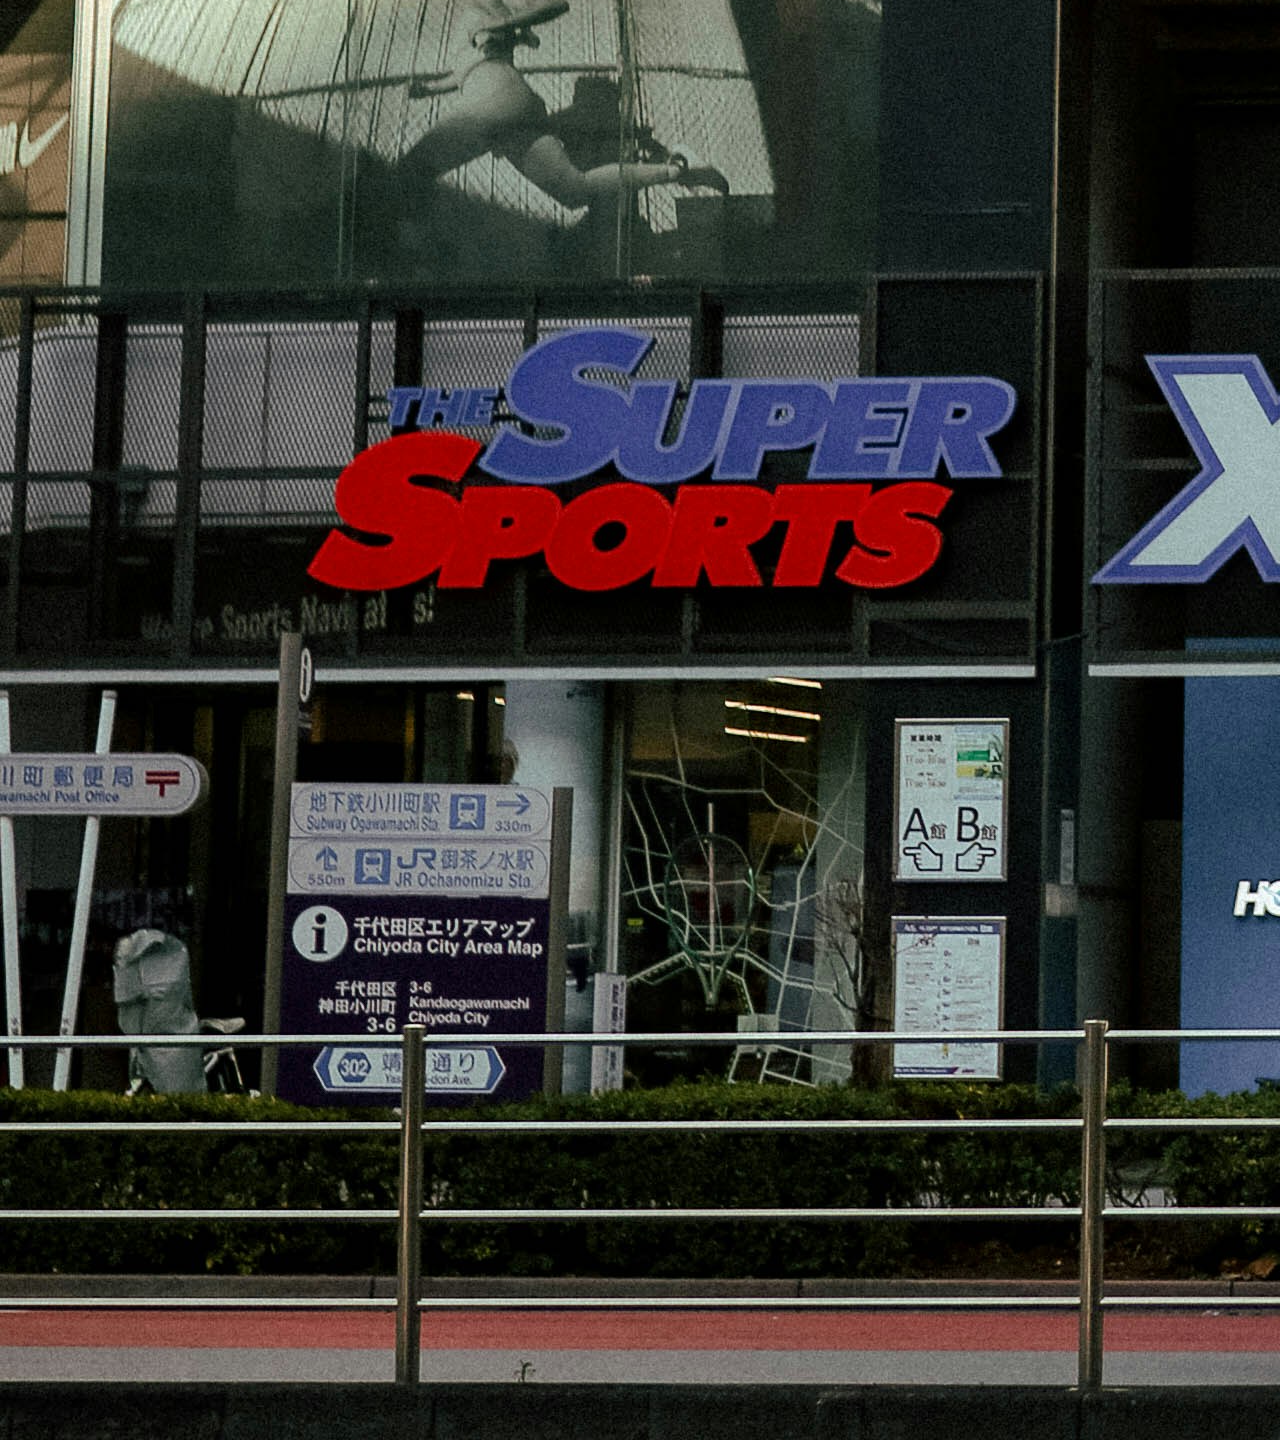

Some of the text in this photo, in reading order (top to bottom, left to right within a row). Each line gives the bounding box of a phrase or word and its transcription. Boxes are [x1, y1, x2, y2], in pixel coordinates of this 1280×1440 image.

[387, 387, 498, 426] THE
[55, 791, 80, 802] Post
[85, 791, 120, 802] Office
[310, 792, 440, 814] 地下鉄小川町駅
[307, 816, 346, 832] Subway
[351, 816, 420, 833] Ogawamachi
[495, 820, 532, 832] 330m
[441, 848, 535, 871] 御茶ノ水駅
[307, 873, 346, 886] 550m
[395, 872, 412, 888] JR
[418, 871, 503, 888] Ochanomizu
[353, 917, 536, 938] 千代田区エリアマップ
[354, 938, 543, 958] Chiyoda City Area Map
[334, 981, 397, 997] 千代田区
[409, 981, 432, 994] 3-6
[318, 998, 396, 1015] 神田小川町
[409, 997, 530, 1011] Kandaogawamachi
[367, 1017, 396, 1032] 3-6
[409, 1011, 490, 1026] Chiyoda City
[340, 1059, 369, 1076] 302
[383, 1051, 475, 1073] 靖通り
